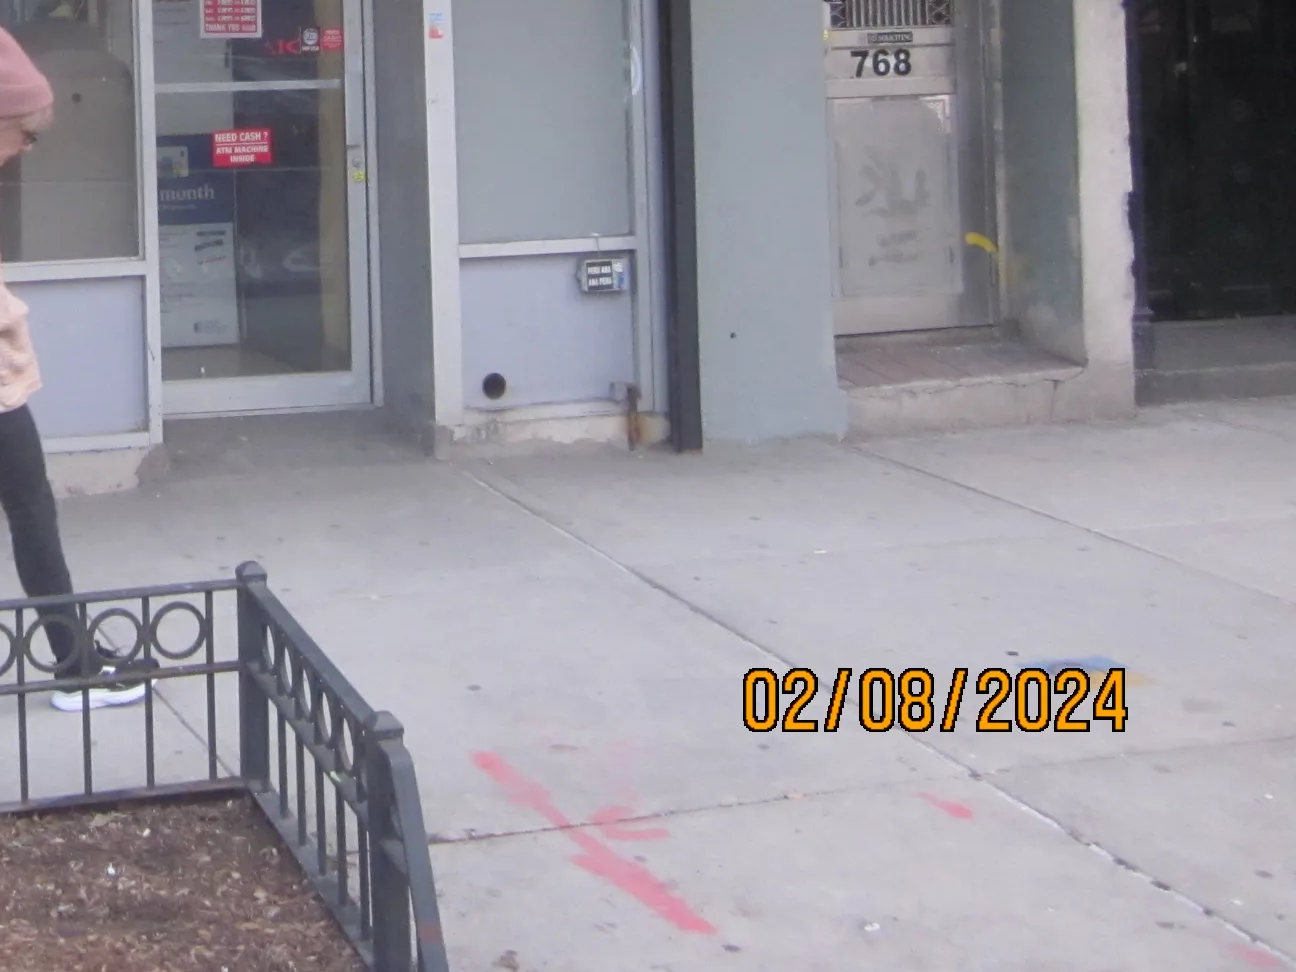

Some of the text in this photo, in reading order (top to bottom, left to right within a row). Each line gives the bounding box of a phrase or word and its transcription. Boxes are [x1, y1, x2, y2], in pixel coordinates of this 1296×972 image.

[850, 49, 912, 78] 768
[215, 132, 237, 143] NEED
[239, 131, 262, 142] CASH
[216, 144, 269, 155] ATM MACHINE
[230, 154, 255, 163] INSIDE
